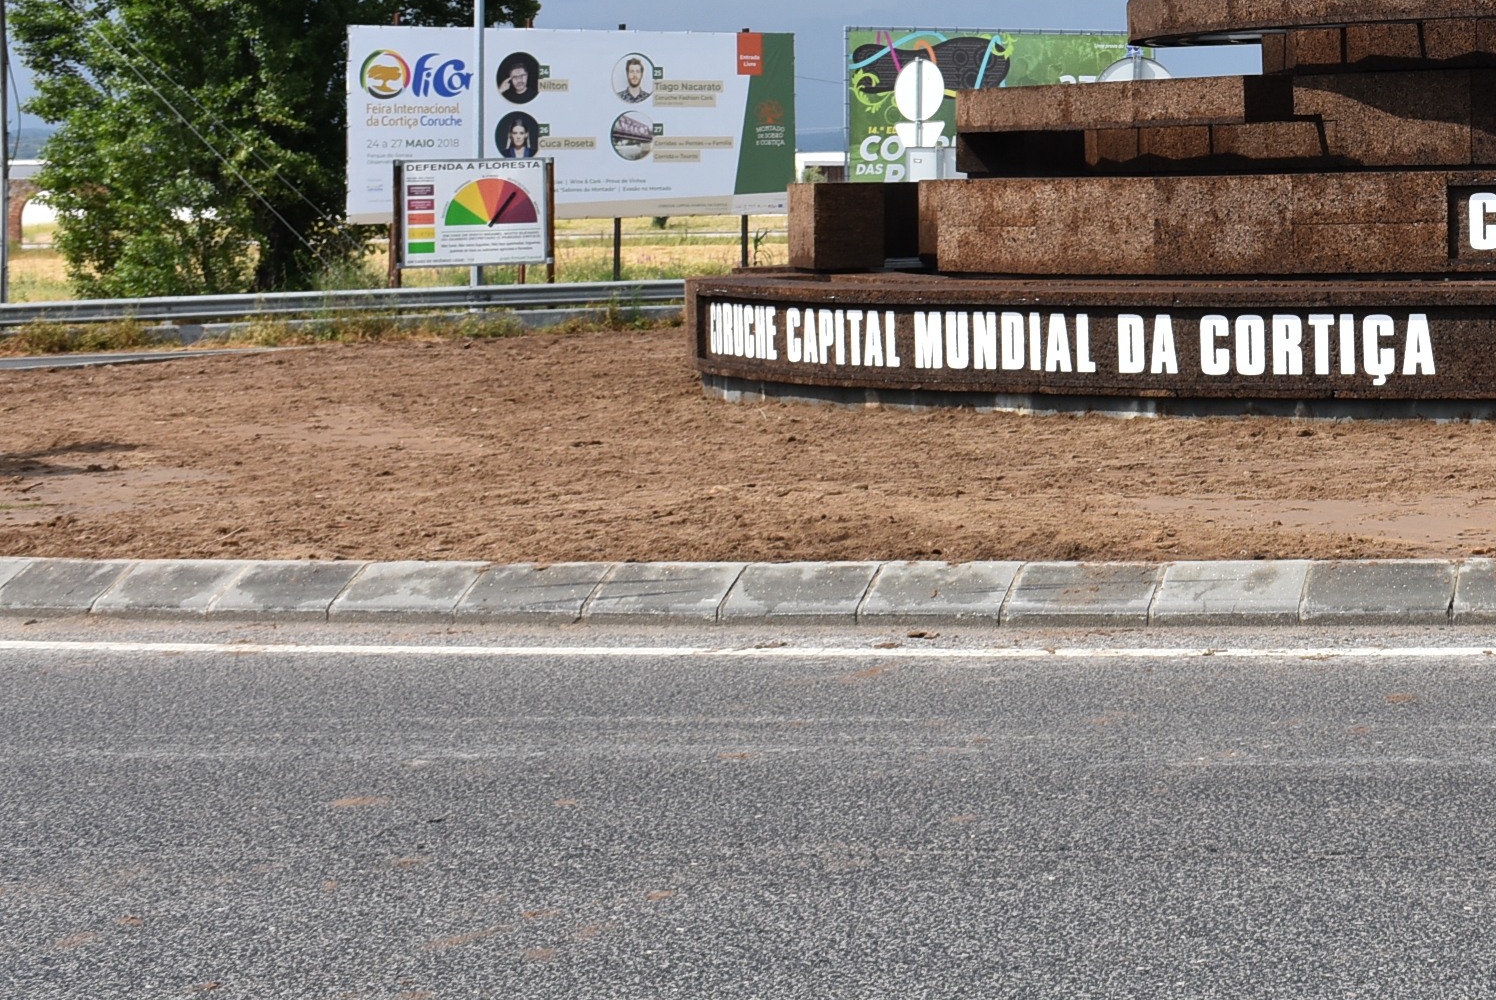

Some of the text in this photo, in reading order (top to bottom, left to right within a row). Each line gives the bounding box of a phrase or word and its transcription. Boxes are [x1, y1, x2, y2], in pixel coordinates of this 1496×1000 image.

[539, 82, 568, 91] Nilton
[654, 82, 721, 93] Tiago Nacarato
[366, 102, 460, 114] Feira Internacional
[366, 115, 463, 129] da Cortiça Coruche
[755, 125, 785, 133] MONTADO
[366, 138, 460, 149] 24 a 27 MAIO 2018
[540, 140, 595, 148] Cuca Roseta
[406, 161, 541, 172] DEFENDA A FLORESTA
[855, 163, 883, 175] DAS
[710, 302, 1436, 386] CORUCHE CAPITAL MUNDIAL DA CORTIÇA
